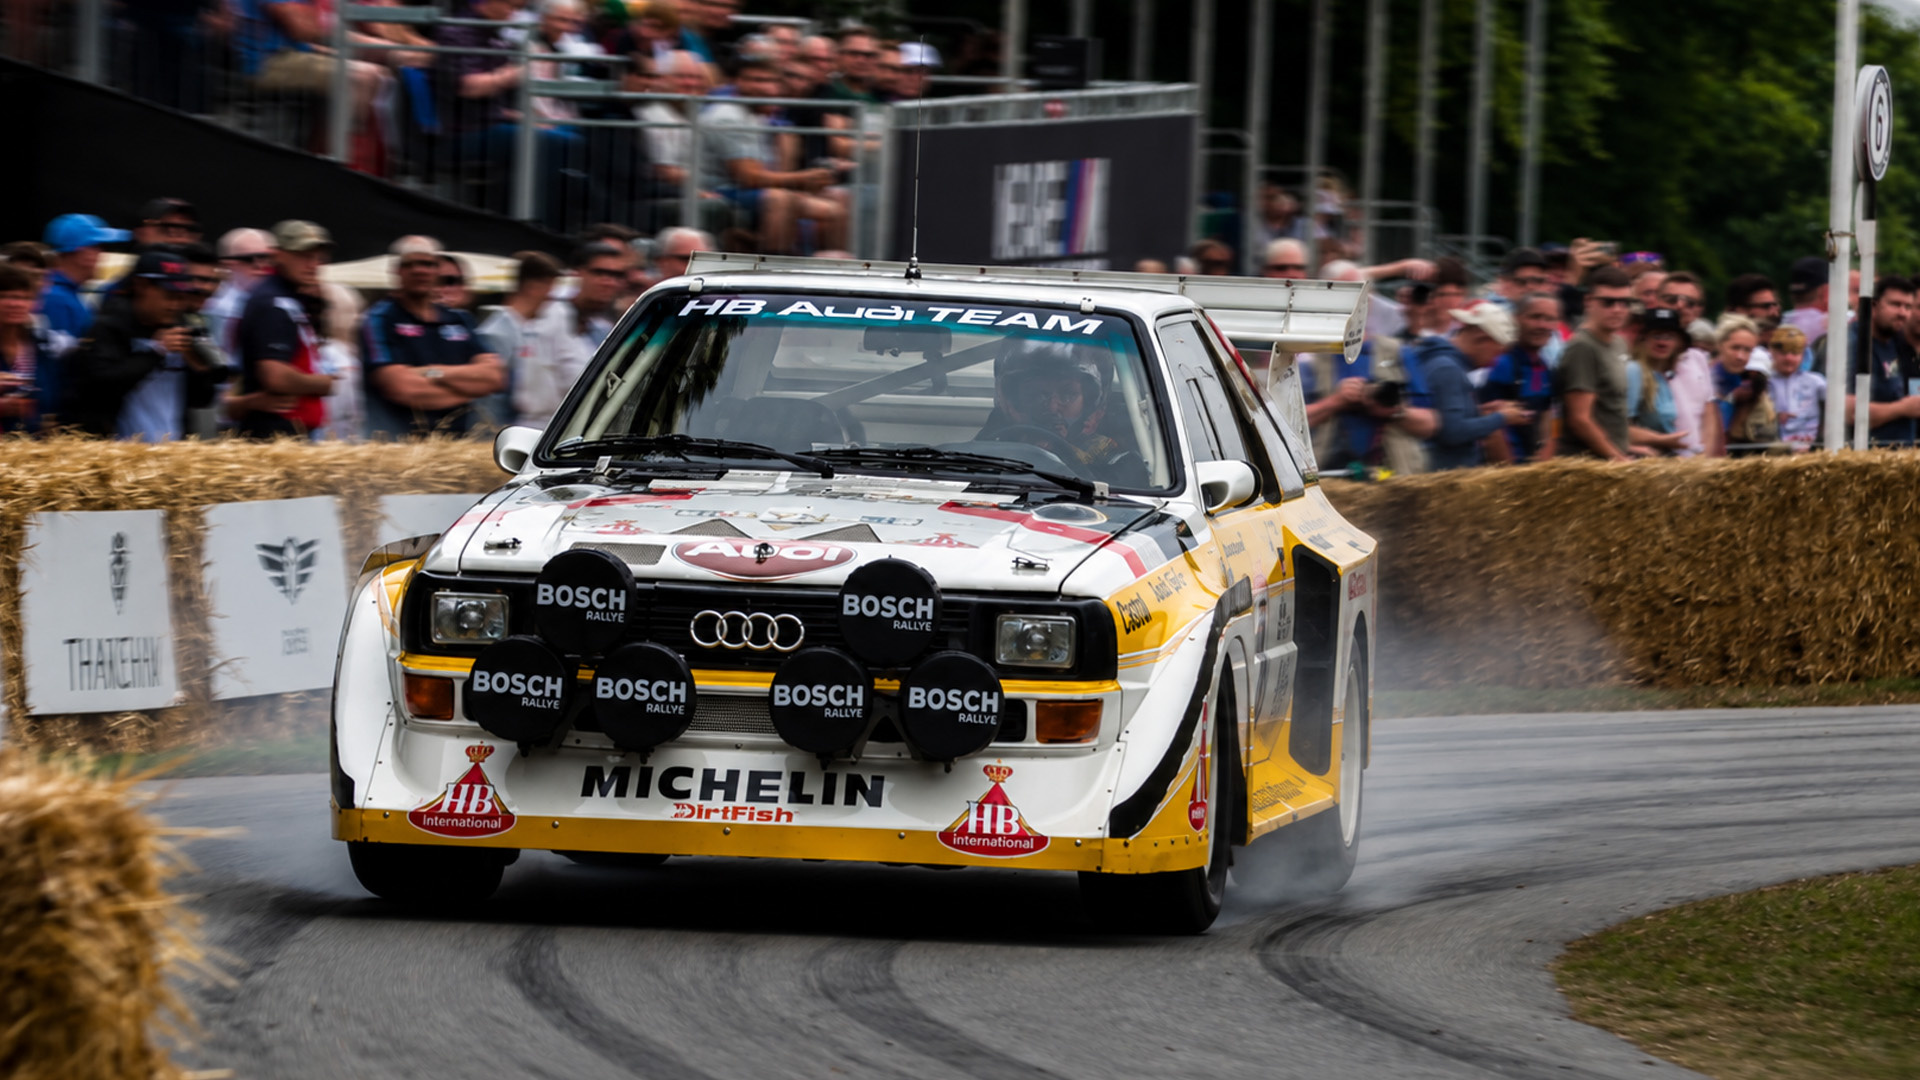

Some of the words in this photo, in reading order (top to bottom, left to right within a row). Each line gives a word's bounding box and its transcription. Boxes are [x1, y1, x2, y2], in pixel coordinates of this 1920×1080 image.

[1875, 95, 1885, 152] 6
[678, 299, 767, 317] HB
[776, 300, 916, 321] Audi
[927, 306, 1104, 335] TEAM
[536, 583, 626, 611] BOSCH
[842, 594, 934, 620] BOSCH
[586, 610, 625, 623] RALLYE
[893, 619, 932, 632] RALLYE
[472, 670, 563, 699] BOSCH
[596, 677, 687, 703] BOSCH
[773, 684, 864, 707] BOSCH
[521, 697, 560, 710] RALLYE
[646, 703, 685, 715] RALLYE
[824, 707, 863, 719] RALLYE
[908, 687, 999, 713] BOSCH
[958, 713, 998, 726] RALLYE
[438, 783, 495, 815] HB
[580, 765, 885, 808] MICHELIN
[672, 803, 793, 823] DirtFish
[967, 801, 1021, 836] HB
